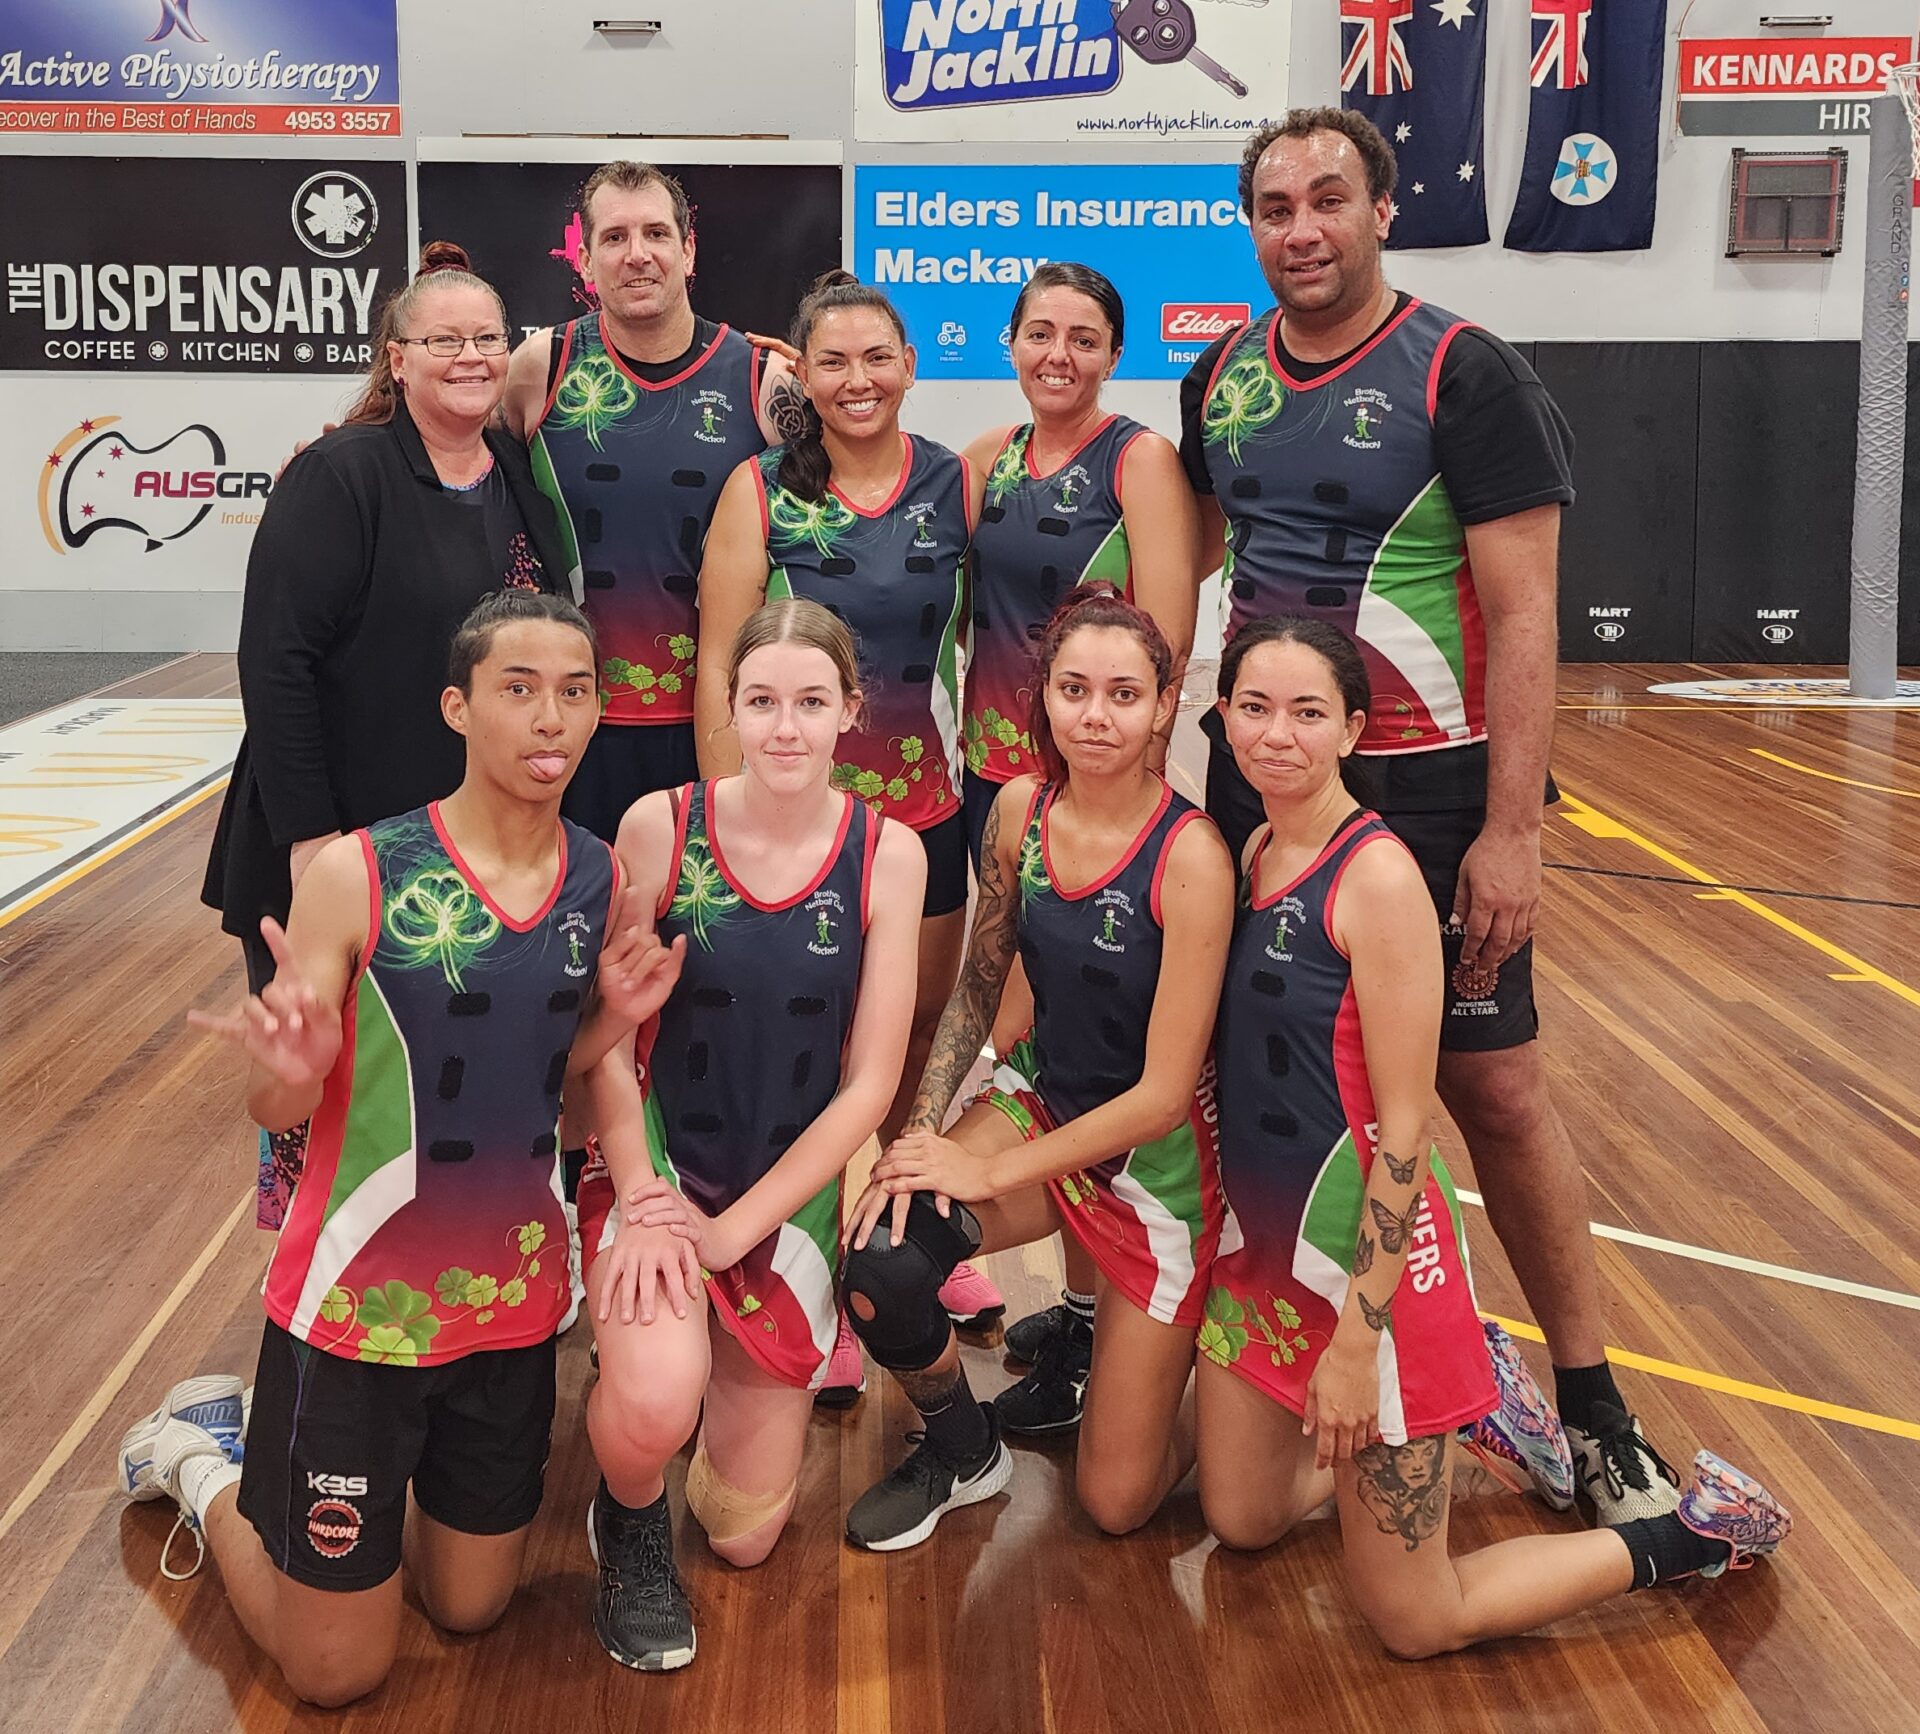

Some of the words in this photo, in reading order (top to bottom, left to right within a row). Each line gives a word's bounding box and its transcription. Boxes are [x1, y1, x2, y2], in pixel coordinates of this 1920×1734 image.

[902, 0, 1078, 52] North
[892, 24, 1112, 102] Jacklin
[1693, 52, 1897, 87] KENNARDS
[0, 50, 110, 87] Active
[120, 48, 380, 101] Physiotherapy
[64, 108, 80, 128] in
[86, 108, 116, 128] the
[122, 108, 165, 129] Best
[170, 108, 191, 129] of
[194, 109, 256, 129] Hands
[285, 112, 336, 130] 4953
[342, 112, 392, 131] 3557
[875, 191, 1020, 227] Elders
[874, 248, 1049, 287] Mackay
[8, 263, 42, 314] THE
[43, 263, 380, 335] DISPENSARY
[45, 340, 136, 360] COFFEE
[182, 342, 280, 361] KITCHEN
[326, 344, 372, 363] BAR
[718, 398, 733, 412] Club
[1343, 395, 1375, 407] Netball
[1375, 397, 1393, 412] Club
[693, 430, 726, 444] Mackay
[1342, 434, 1381, 449] Mackay
[1589, 606, 1631, 617] HART
[1757, 609, 1800, 619] HART
[804, 898, 832, 912] Netball
[1120, 900, 1134, 915] Club
[807, 941, 839, 956] Mackay
[1451, 1008, 1469, 1016] ALL
[1471, 1006, 1499, 1016] STARS
[1455, 1000, 1496, 1008] INDIGENOUS
[308, 1520, 360, 1540] HARDCORE
